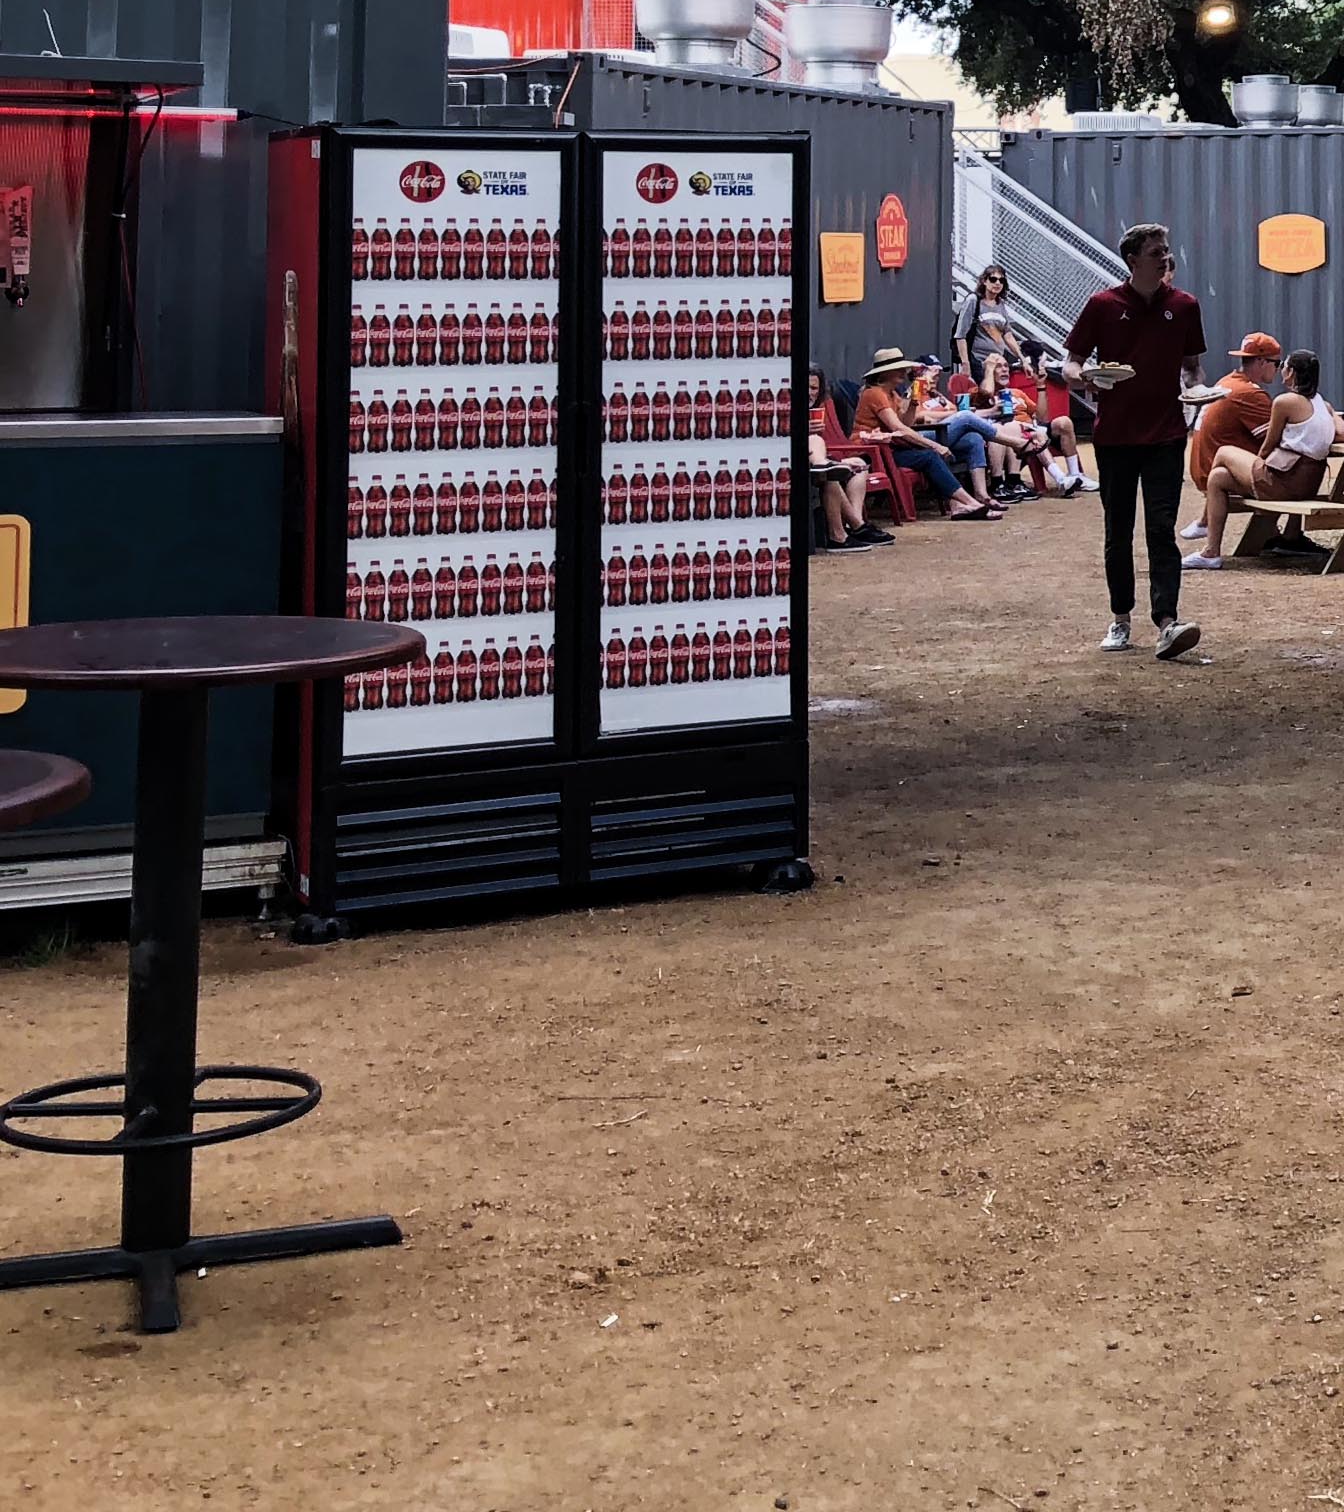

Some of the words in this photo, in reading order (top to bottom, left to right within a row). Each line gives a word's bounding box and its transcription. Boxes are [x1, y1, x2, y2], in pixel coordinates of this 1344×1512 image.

[482, 171, 507, 180] STATE
[509, 171, 527, 180] FAIR
[712, 172, 734, 180] STATE
[737, 172, 753, 180] FAIR
[483, 184, 527, 195] TEXAS
[712, 185, 753, 196] TEXAS
[880, 225, 905, 249] STEAK
